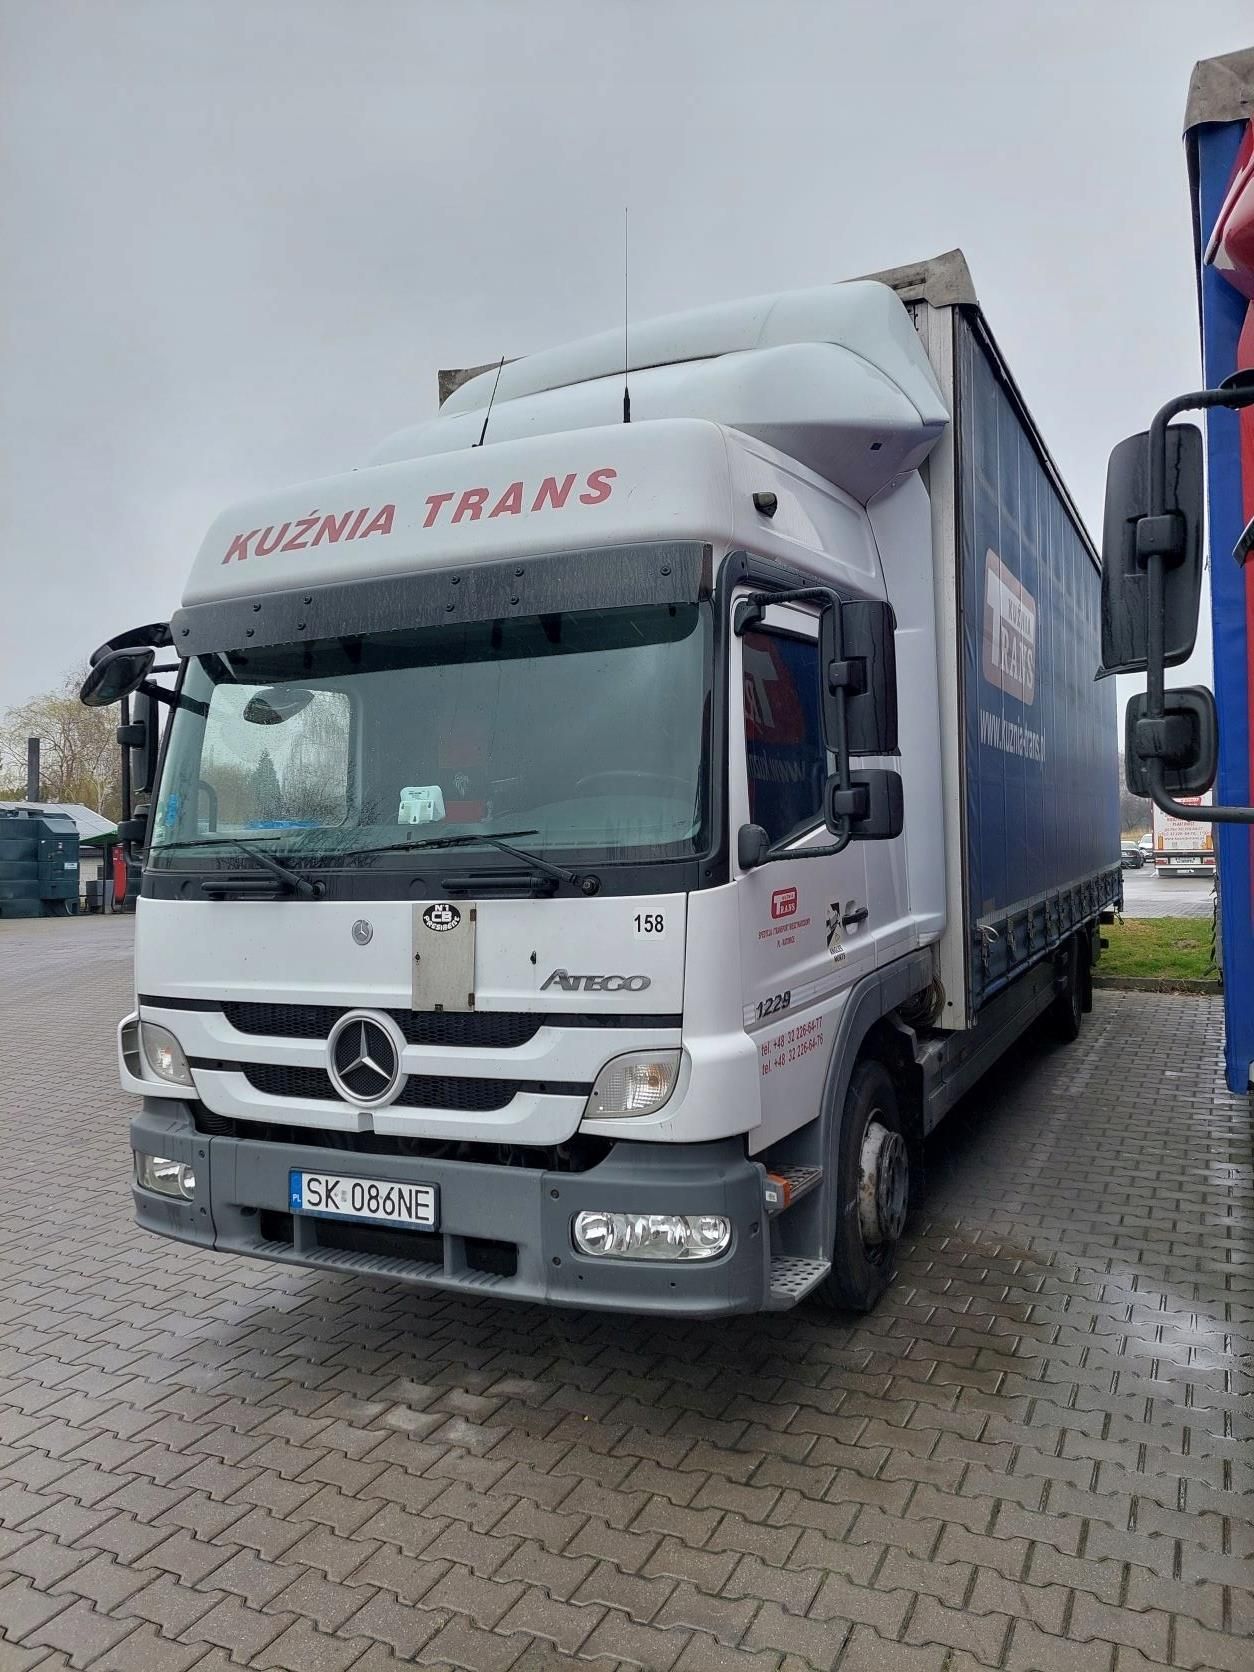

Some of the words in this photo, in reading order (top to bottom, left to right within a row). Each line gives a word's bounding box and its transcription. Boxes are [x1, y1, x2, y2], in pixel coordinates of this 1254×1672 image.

[220, 504, 396, 565] KUŹNIA
[422, 467, 618, 529] TRANS
[431, 911, 452, 923] CB
[634, 913, 665, 933] 158
[756, 990, 792, 1020] 1229
[761, 1040, 772, 1057] tel.
[773, 1033, 785, 1049] +48
[762, 1059, 773, 1076] tel.
[774, 1052, 786, 1067] +48
[292, 1194, 302, 1203] PL
[306, 1177, 341, 1210] SK
[351, 1182, 430, 1222] 086NE
